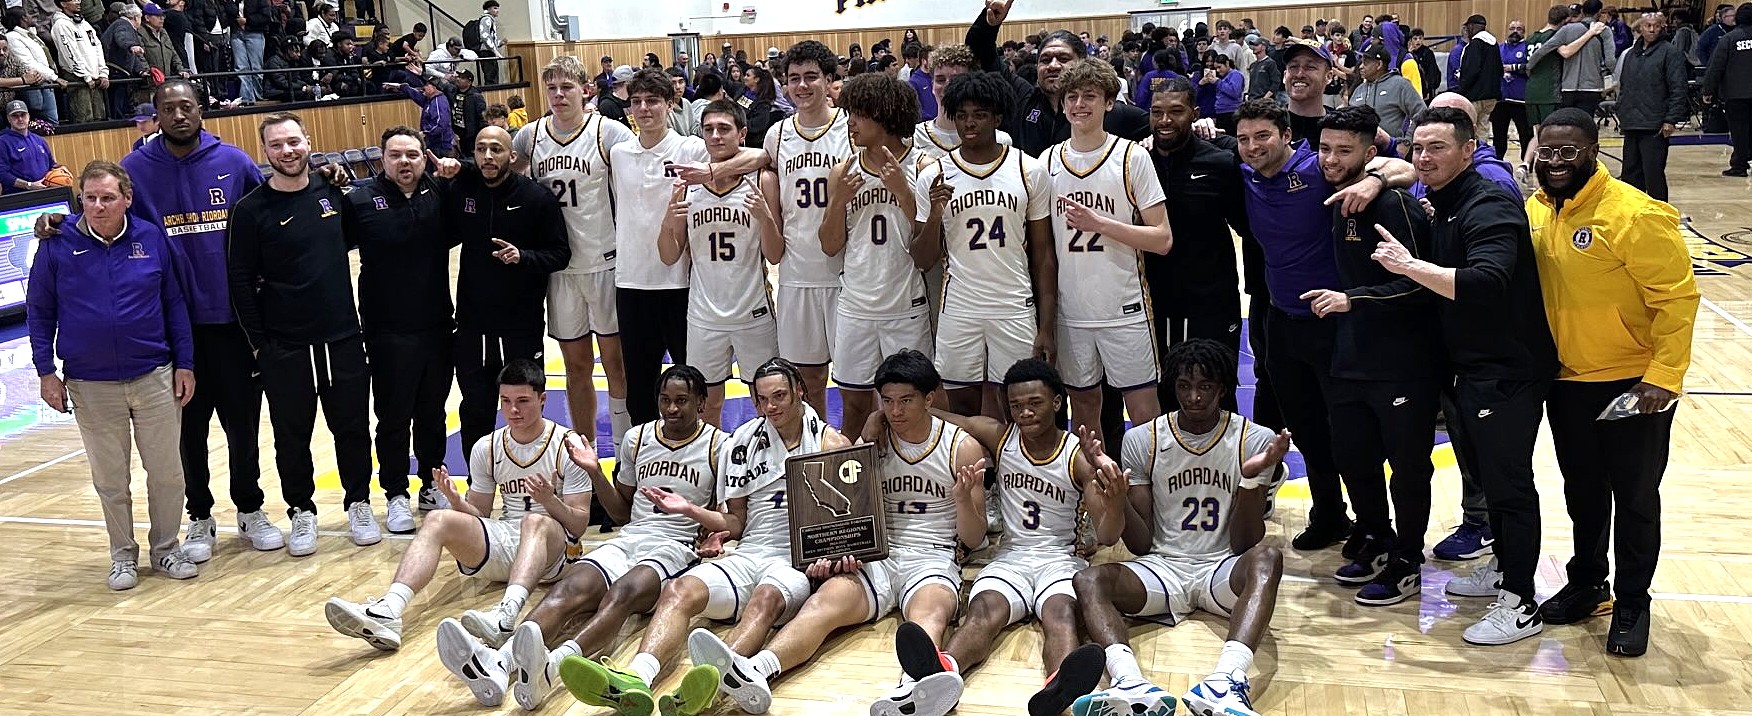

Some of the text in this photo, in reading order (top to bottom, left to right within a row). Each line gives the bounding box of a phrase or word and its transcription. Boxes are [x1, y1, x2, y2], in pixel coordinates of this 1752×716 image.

[538, 155, 591, 177] RIORDAN
[209, 188, 226, 205] R
[373, 196, 389, 210] R
[464, 197, 476, 213] R
[552, 179, 578, 207] 21
[795, 177, 829, 208] 30
[851, 188, 902, 214] RIORDA
[950, 189, 1018, 217] RIORDAN
[163, 211, 200, 227] ARCHBSHO
[692, 207, 751, 229] RIORDAN
[871, 214, 887, 245] 0
[966, 215, 1006, 250] 24
[708, 232, 736, 261] 15
[500, 478, 527, 495] RIOR
[638, 460, 700, 487] RIORDAN
[725, 461, 769, 488] ATOADE
[882, 475, 946, 498] RIORDAN
[1168, 467, 1232, 494] RIORDAN
[1003, 473, 1066, 504] RIORDAN
[1023, 500, 1040, 530] 3
[1181, 497, 1220, 531] 23
